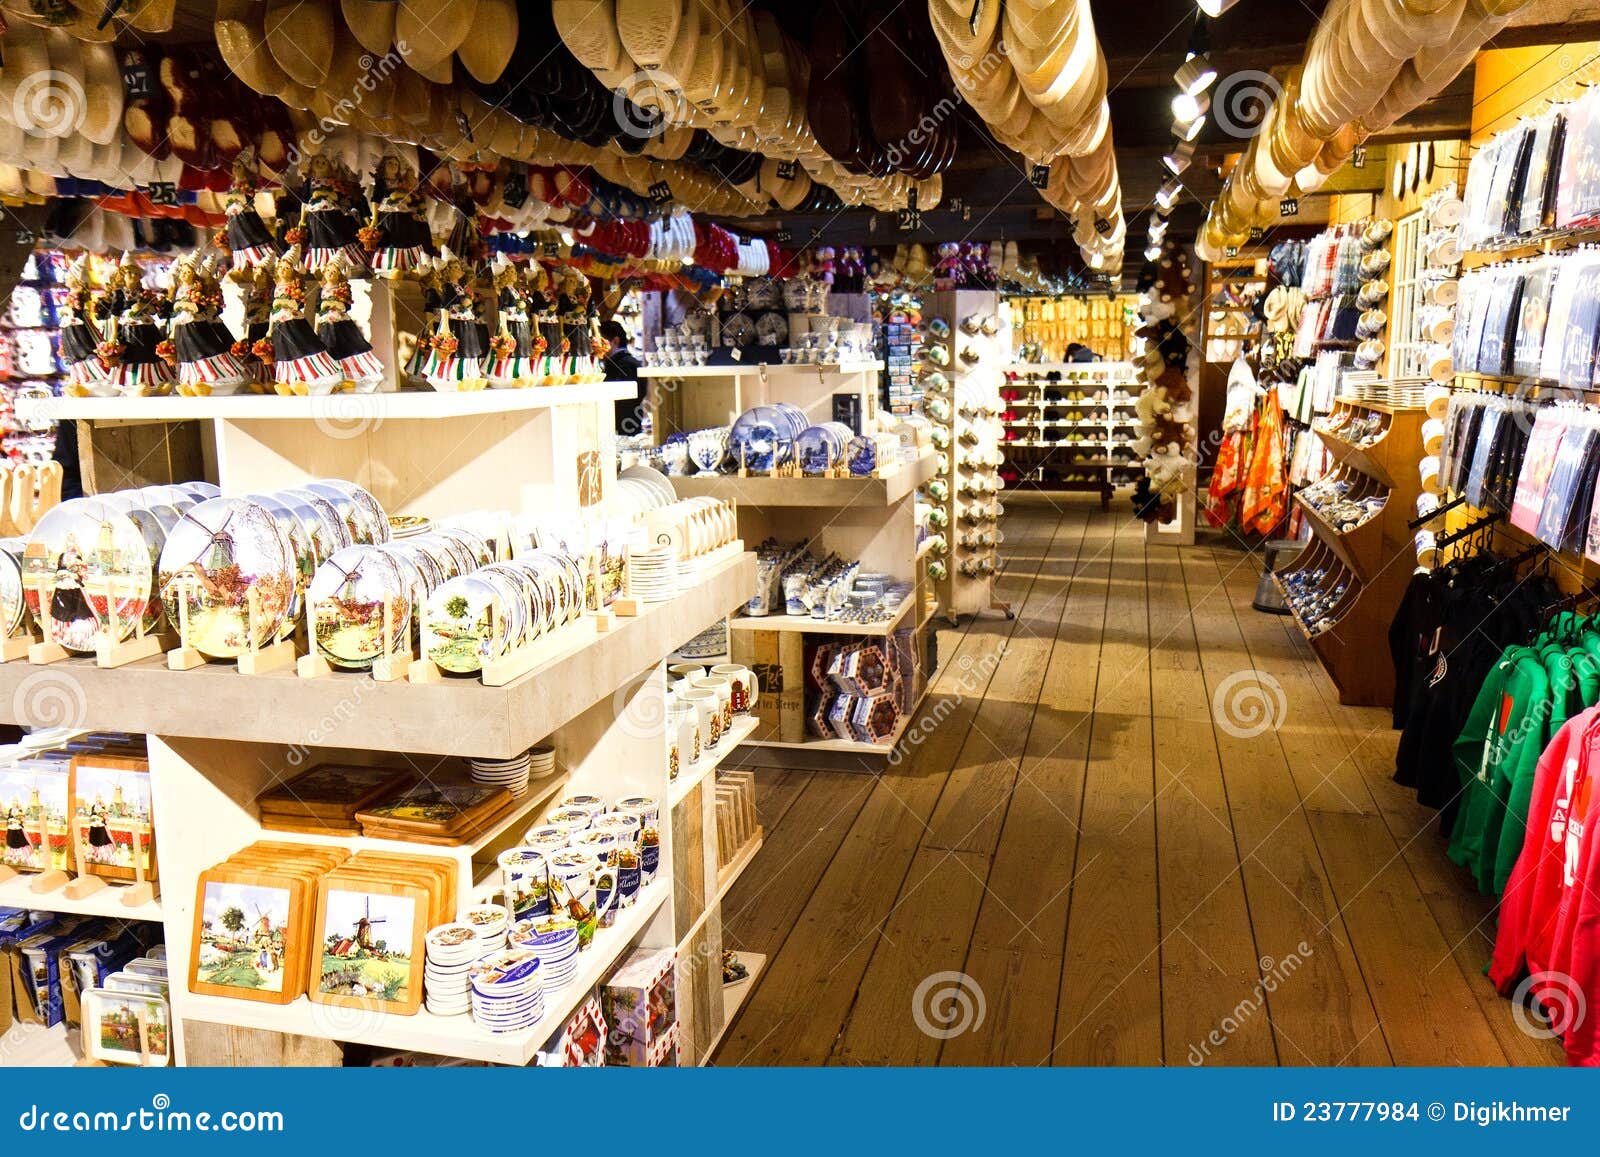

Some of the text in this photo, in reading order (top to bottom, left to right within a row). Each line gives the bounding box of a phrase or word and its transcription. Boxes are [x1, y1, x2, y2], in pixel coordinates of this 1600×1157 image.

[124, 72, 147, 93] 27
[150, 184, 177, 204] 25
[1281, 203, 1298, 215] 26
